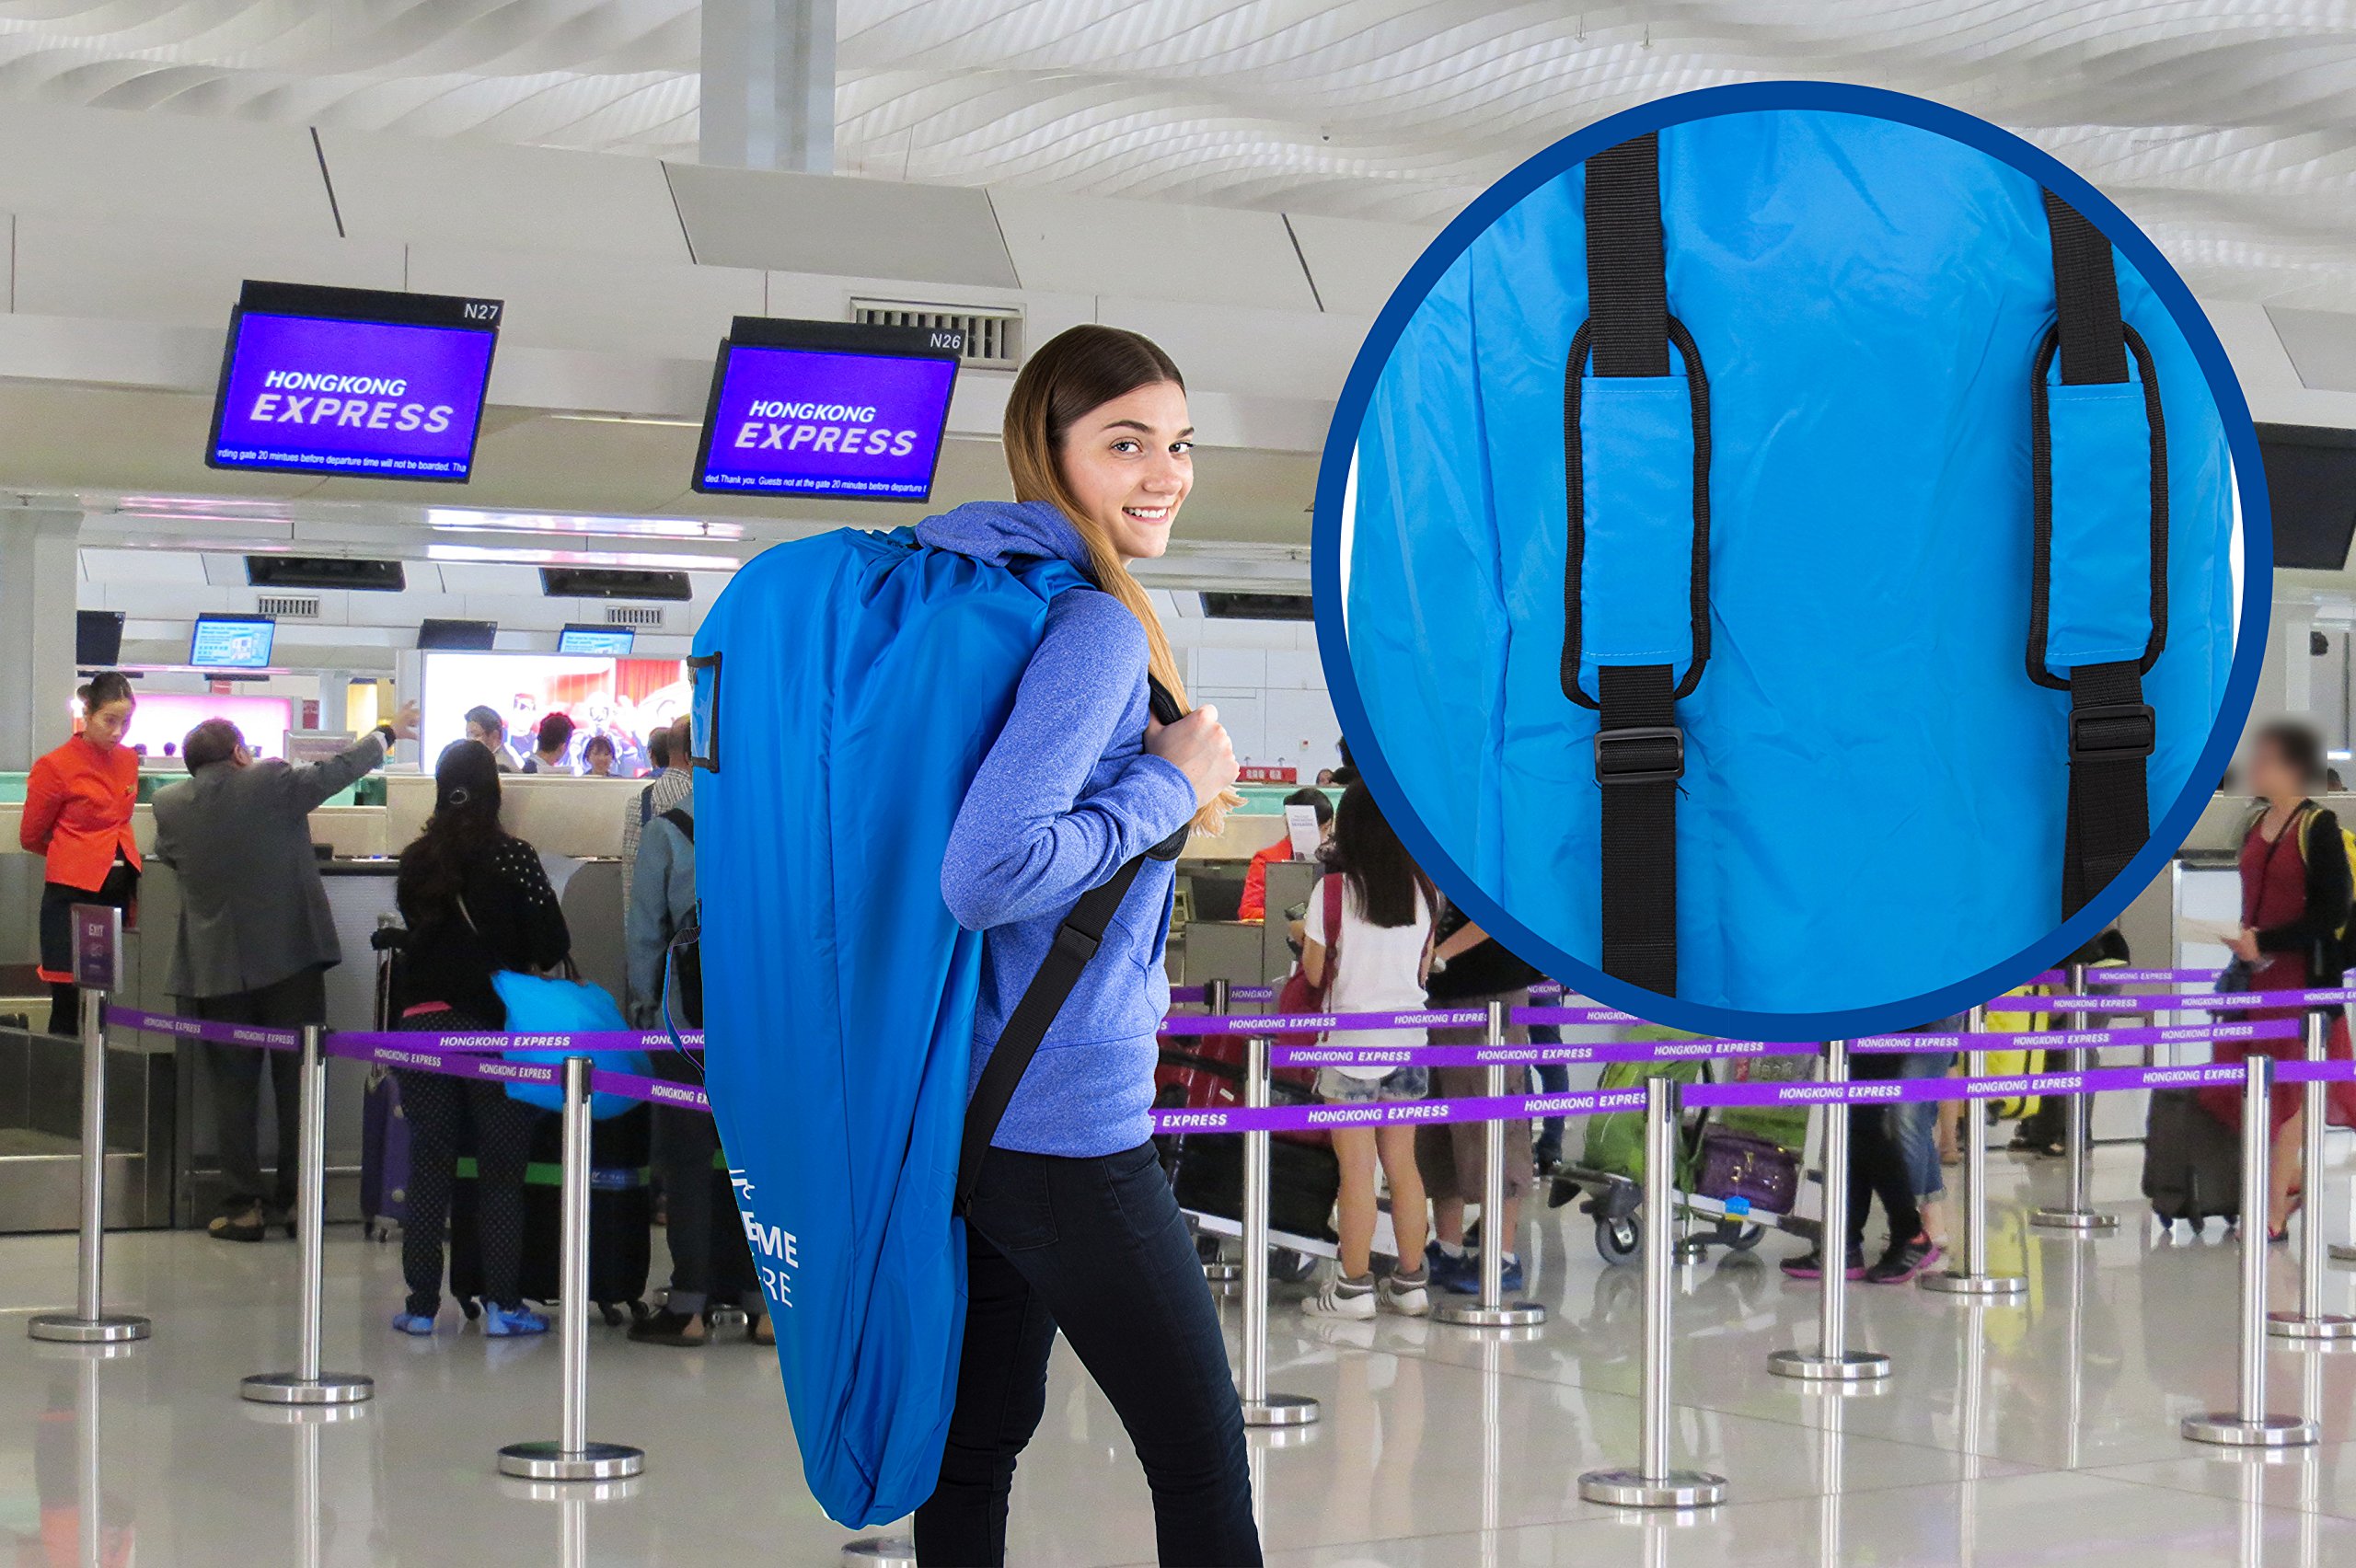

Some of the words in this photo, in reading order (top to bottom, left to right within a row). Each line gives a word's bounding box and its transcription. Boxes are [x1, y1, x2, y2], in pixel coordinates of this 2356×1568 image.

[465, 304, 499, 319] N27
[930, 333, 961, 350] N26
[265, 371, 407, 397] HONGKONG
[250, 393, 454, 432] EXPRESS
[748, 400, 876, 422] HONGKONG
[734, 422, 917, 456] EXPRESS
[216, 449, 238, 460] rding
[239, 451, 257, 460] gate
[258, 450, 268, 459] 20
[300, 454, 325, 464] before
[326, 455, 362, 467] departure
[363, 457, 379, 467] time
[380, 458, 393, 467] will
[394, 460, 406, 468] not
[407, 460, 417, 469] be
[418, 461, 450, 471] boarded.
[721, 474, 742, 484] Thank
[758, 476, 782, 486] Guests
[783, 478, 794, 487] not
[795, 478, 803, 487] at
[803, 478, 815, 488] the
[815, 479, 831, 490] gate
[831, 479, 841, 489] 20
[868, 481, 889, 491] before
[890, 482, 922, 493] departure
[89, 924, 104, 938] EXIT
[1527, 985, 1560, 994] NGKONG
[2304, 992, 2344, 1001] HONGKONG
[2053, 999, 2097, 1009] HONGKONG
[2100, 998, 2138, 1008] EXPRESS
[2181, 997, 2223, 1007] HONGKONG
[2225, 996, 2262, 1005] EXPRESS
[143, 1016, 174, 1030] HONGKONG
[175, 1021, 202, 1034] EXPRESS
[1230, 1019, 1286, 1029] HONGKONG
[1289, 1017, 1336, 1027] EXPRESS
[1394, 1013, 1448, 1024] HONGKONG
[233, 1030, 265, 1043] HONGKONG
[267, 1033, 294, 1045] EXPRESS
[2013, 1035, 2063, 1045] HONGKONG
[2067, 1033, 2110, 1043] EXPRESS
[2161, 1029, 2209, 1039] HONGKONG
[2212, 1026, 2254, 1037] EXPRESS
[440, 1036, 508, 1046] HONGKONG
[513, 1036, 571, 1046] EXPRESS
[1654, 1044, 1712, 1055] HONGKONG
[1715, 1042, 1763, 1053] EXPRESS
[1857, 1038, 1911, 1047] HONGKONG
[1914, 1037, 1959, 1047] EXPRESS
[374, 1047, 410, 1063] HONGKONG
[411, 1053, 442, 1067] EXPRESS
[1289, 1051, 1353, 1061] HONGKONG
[1357, 1051, 1411, 1061] EXPRESS
[1477, 1050, 1537, 1060] HONGKONG
[1542, 1048, 1592, 1059] EXPRESS
[479, 1063, 516, 1077] HONGKONG
[519, 1066, 551, 1080] EXPRESS
[2142, 1070, 2199, 1083] HONGKONG
[2204, 1068, 2246, 1080] EXPRES
[1779, 1088, 1843, 1099] HONGKONG
[1848, 1085, 1902, 1098] EXPRESS
[1967, 1080, 2028, 1093] HONGKONG
[2032, 1077, 2082, 1090] EXPRESS
[652, 1085, 695, 1102] HONGKONG
[1524, 1097, 1593, 1112] HONGKONG
[1600, 1092, 1646, 1107] EXPRES
[1162, 1113, 1228, 1126] EXPRESS
[1308, 1108, 1381, 1123] HONGKONG
[1388, 1105, 1449, 1120] EXPRESS
[742, 1211, 799, 1269] EME
